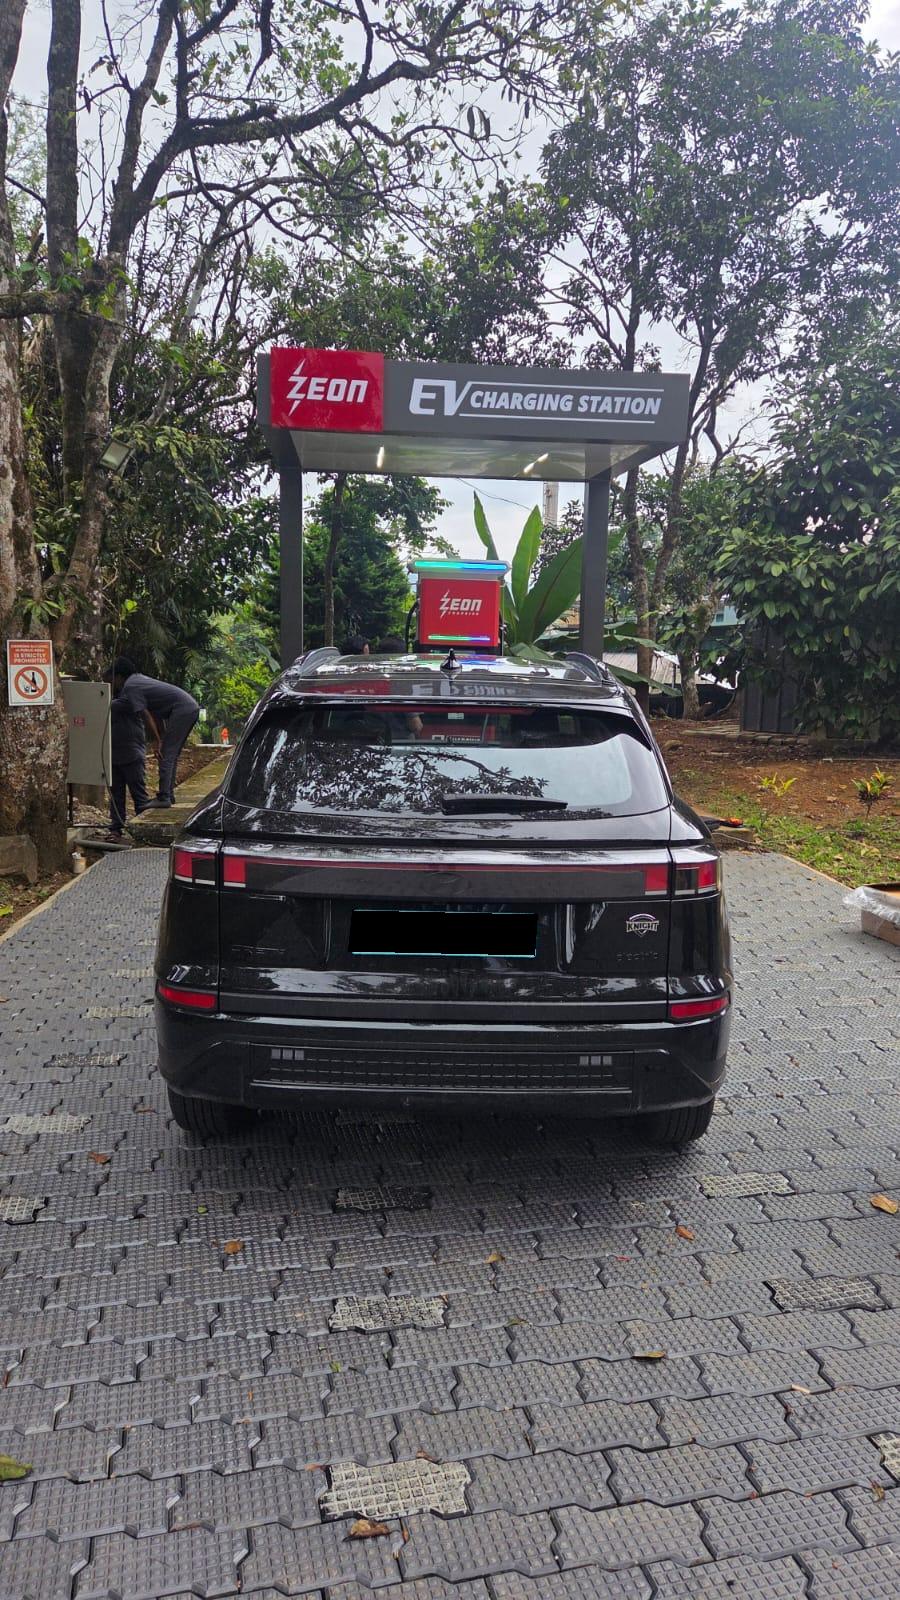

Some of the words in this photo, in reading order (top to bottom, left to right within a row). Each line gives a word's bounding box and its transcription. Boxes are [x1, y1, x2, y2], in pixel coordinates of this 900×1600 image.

[286, 359, 368, 416] ZEON
[409, 378, 472, 416] EV
[470, 389, 573, 414] CHARGING
[577, 395, 661, 415] STATION
[439, 589, 482, 618] ZEON
[626, 921, 659, 932] KNIGHT
